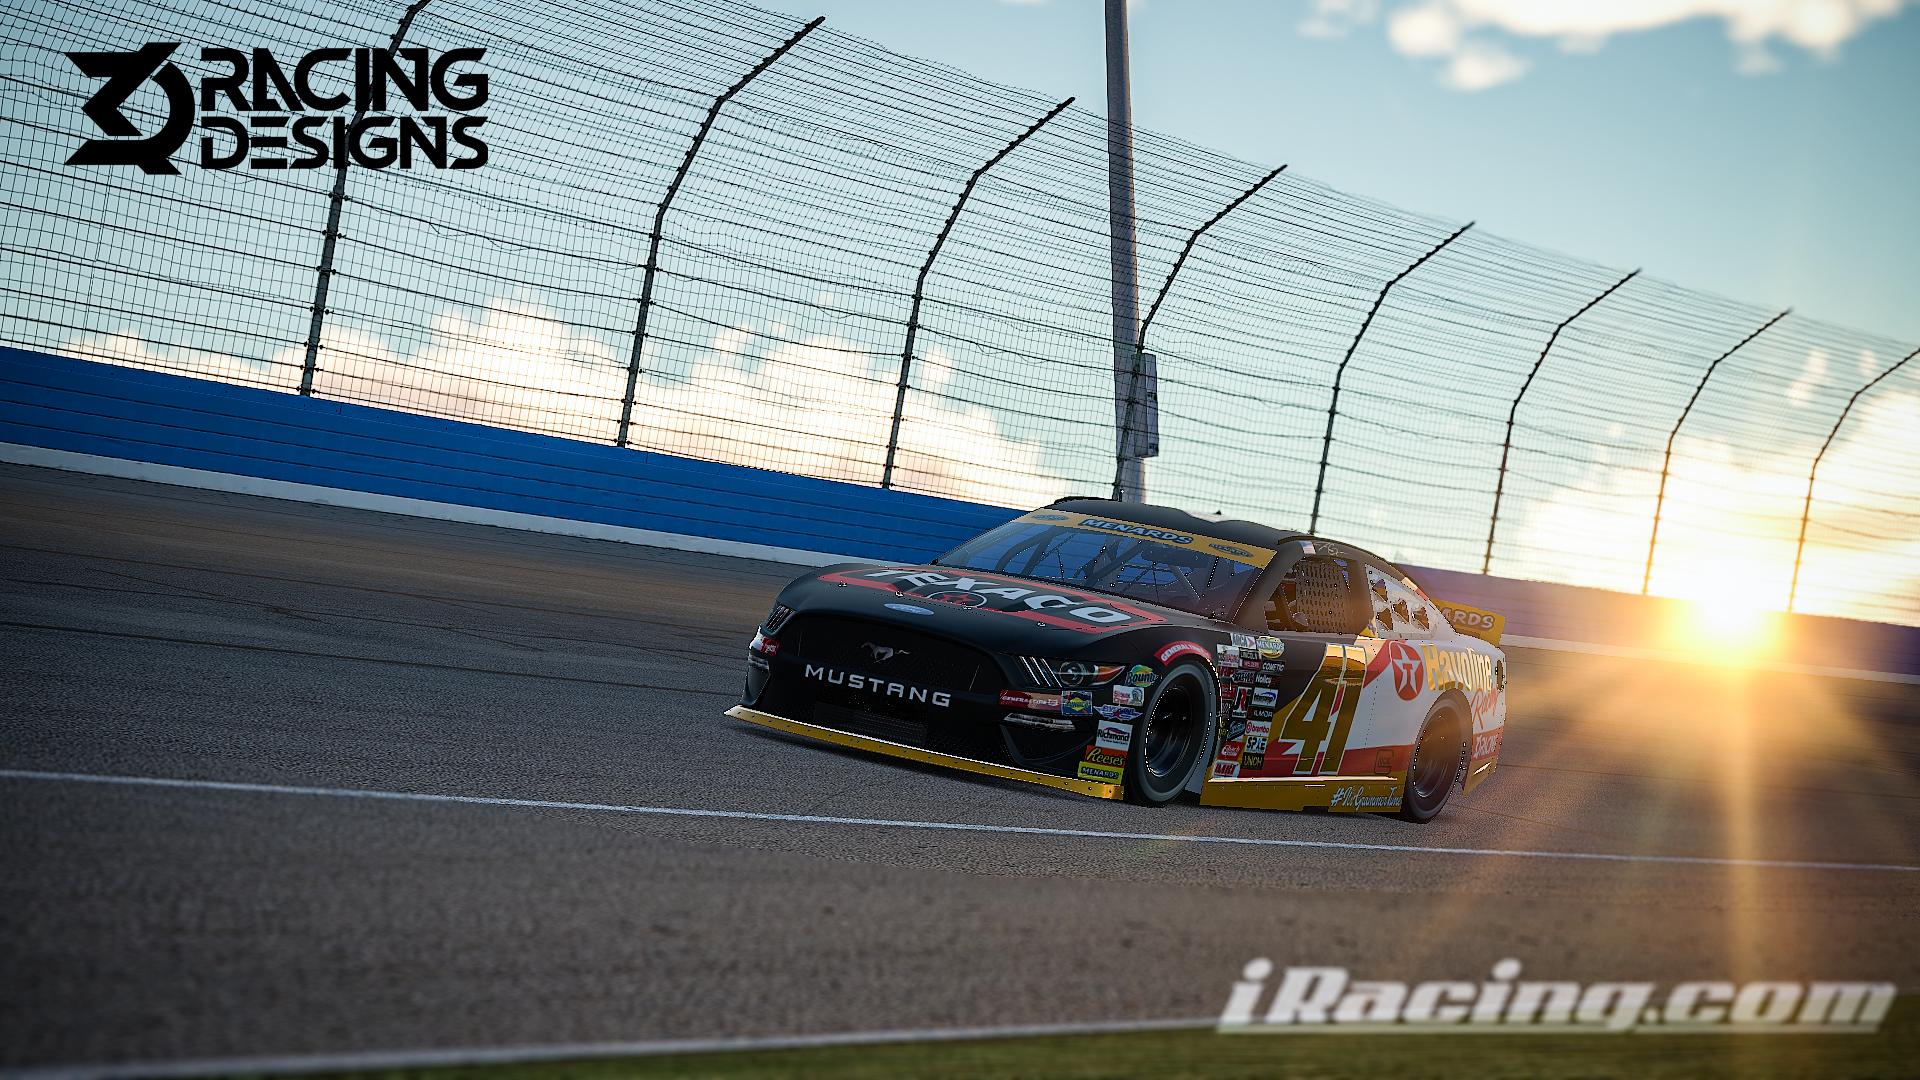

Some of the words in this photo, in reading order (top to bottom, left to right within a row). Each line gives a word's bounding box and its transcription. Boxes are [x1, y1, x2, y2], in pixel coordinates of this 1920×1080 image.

[1080, 518, 1194, 545] MENARDS
[864, 569, 1132, 624] TEXACO
[1262, 662, 1285, 672] COMETIC
[1419, 643, 1492, 693] Havoline
[804, 663, 952, 708] MUSTANG
[1278, 642, 1367, 775] 41
[1096, 728, 1131, 742] Richmond
[1081, 766, 1120, 779] MENARDS
